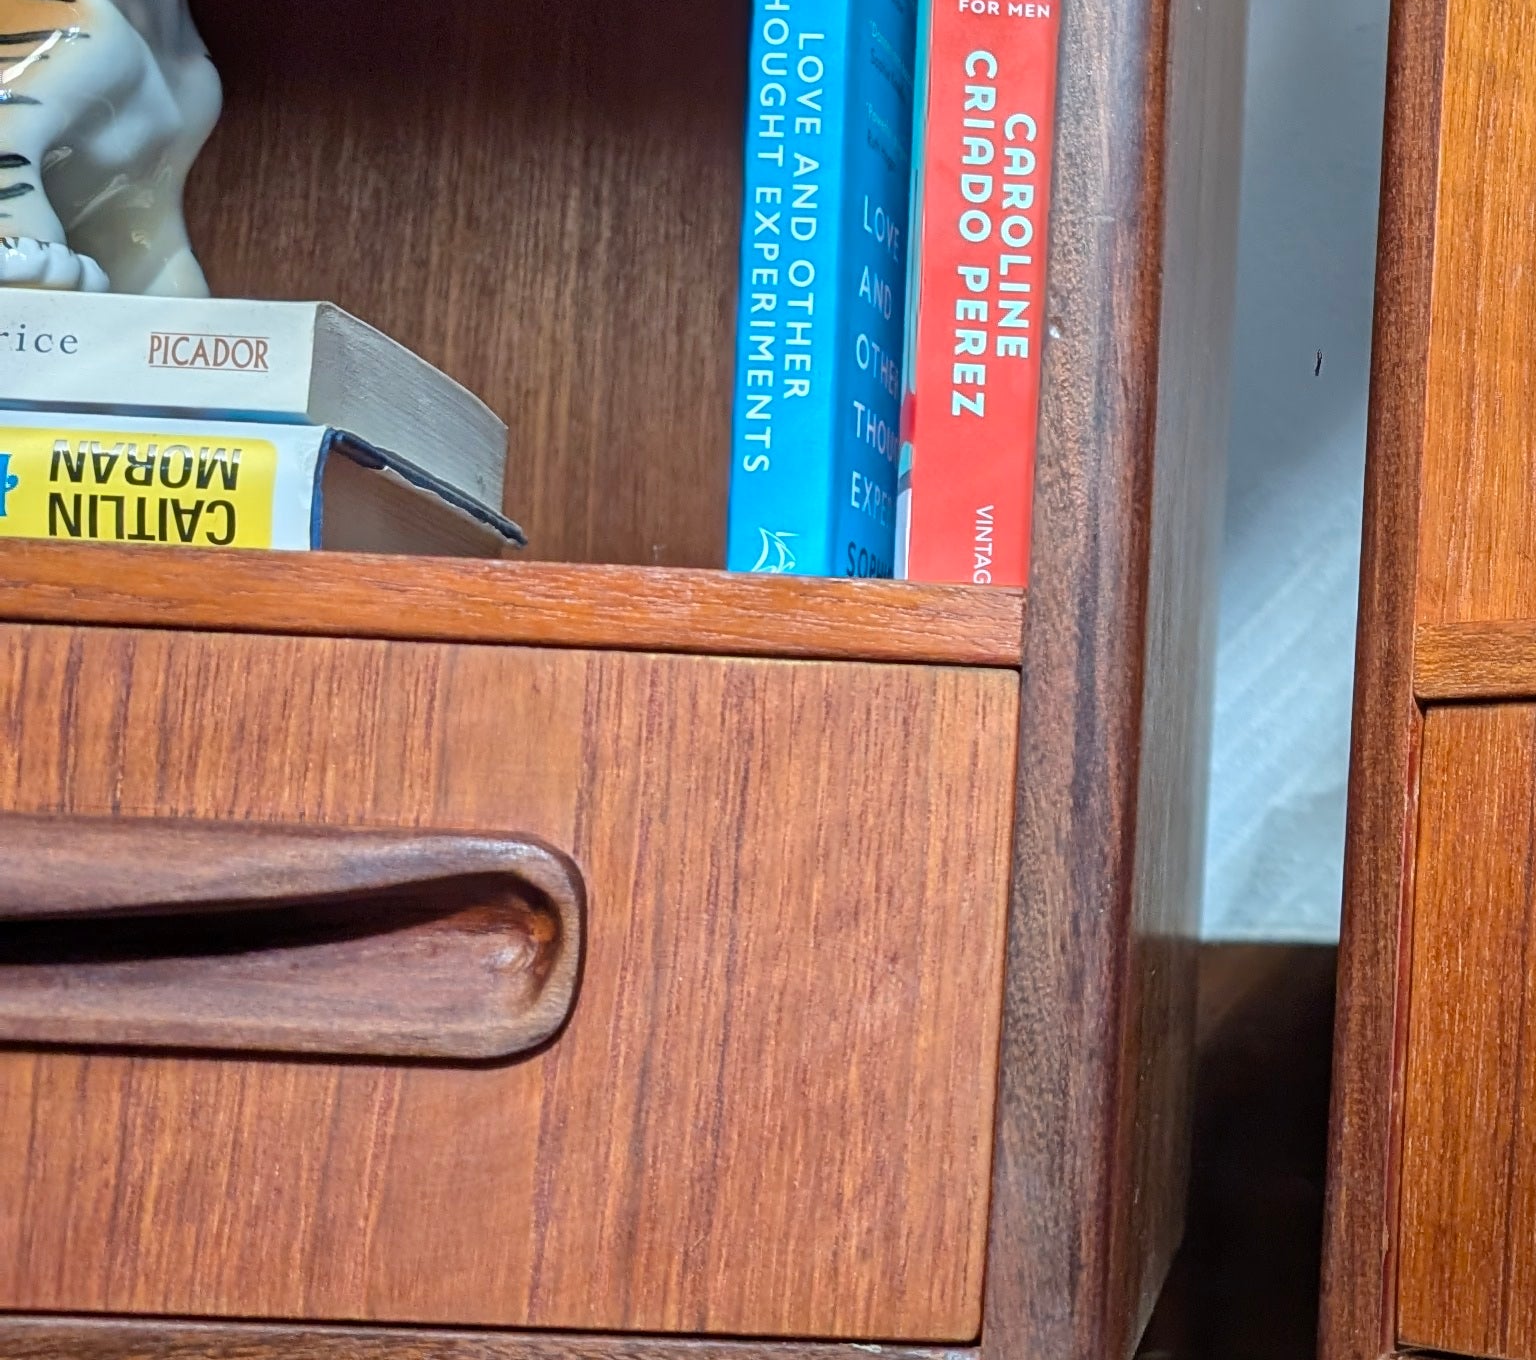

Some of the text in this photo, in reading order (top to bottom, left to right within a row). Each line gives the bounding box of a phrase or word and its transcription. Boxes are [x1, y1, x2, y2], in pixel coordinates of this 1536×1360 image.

[1008, 2, 1050, 18] MEN
[783, 32, 824, 399] LOVE AND OTHER
[863, 195, 900, 264] LOVE
[951, 50, 998, 418] CRIADO PEREZ
[996, 113, 1037, 359] CAROLINE
[859, 265, 892, 321] AND
[148, 334, 269, 370] PICADOR
[743, 187, 782, 472] EXPERIMENTS
[49, 439, 242, 491] MORAN
[48, 492, 236, 546] CAITLIN
